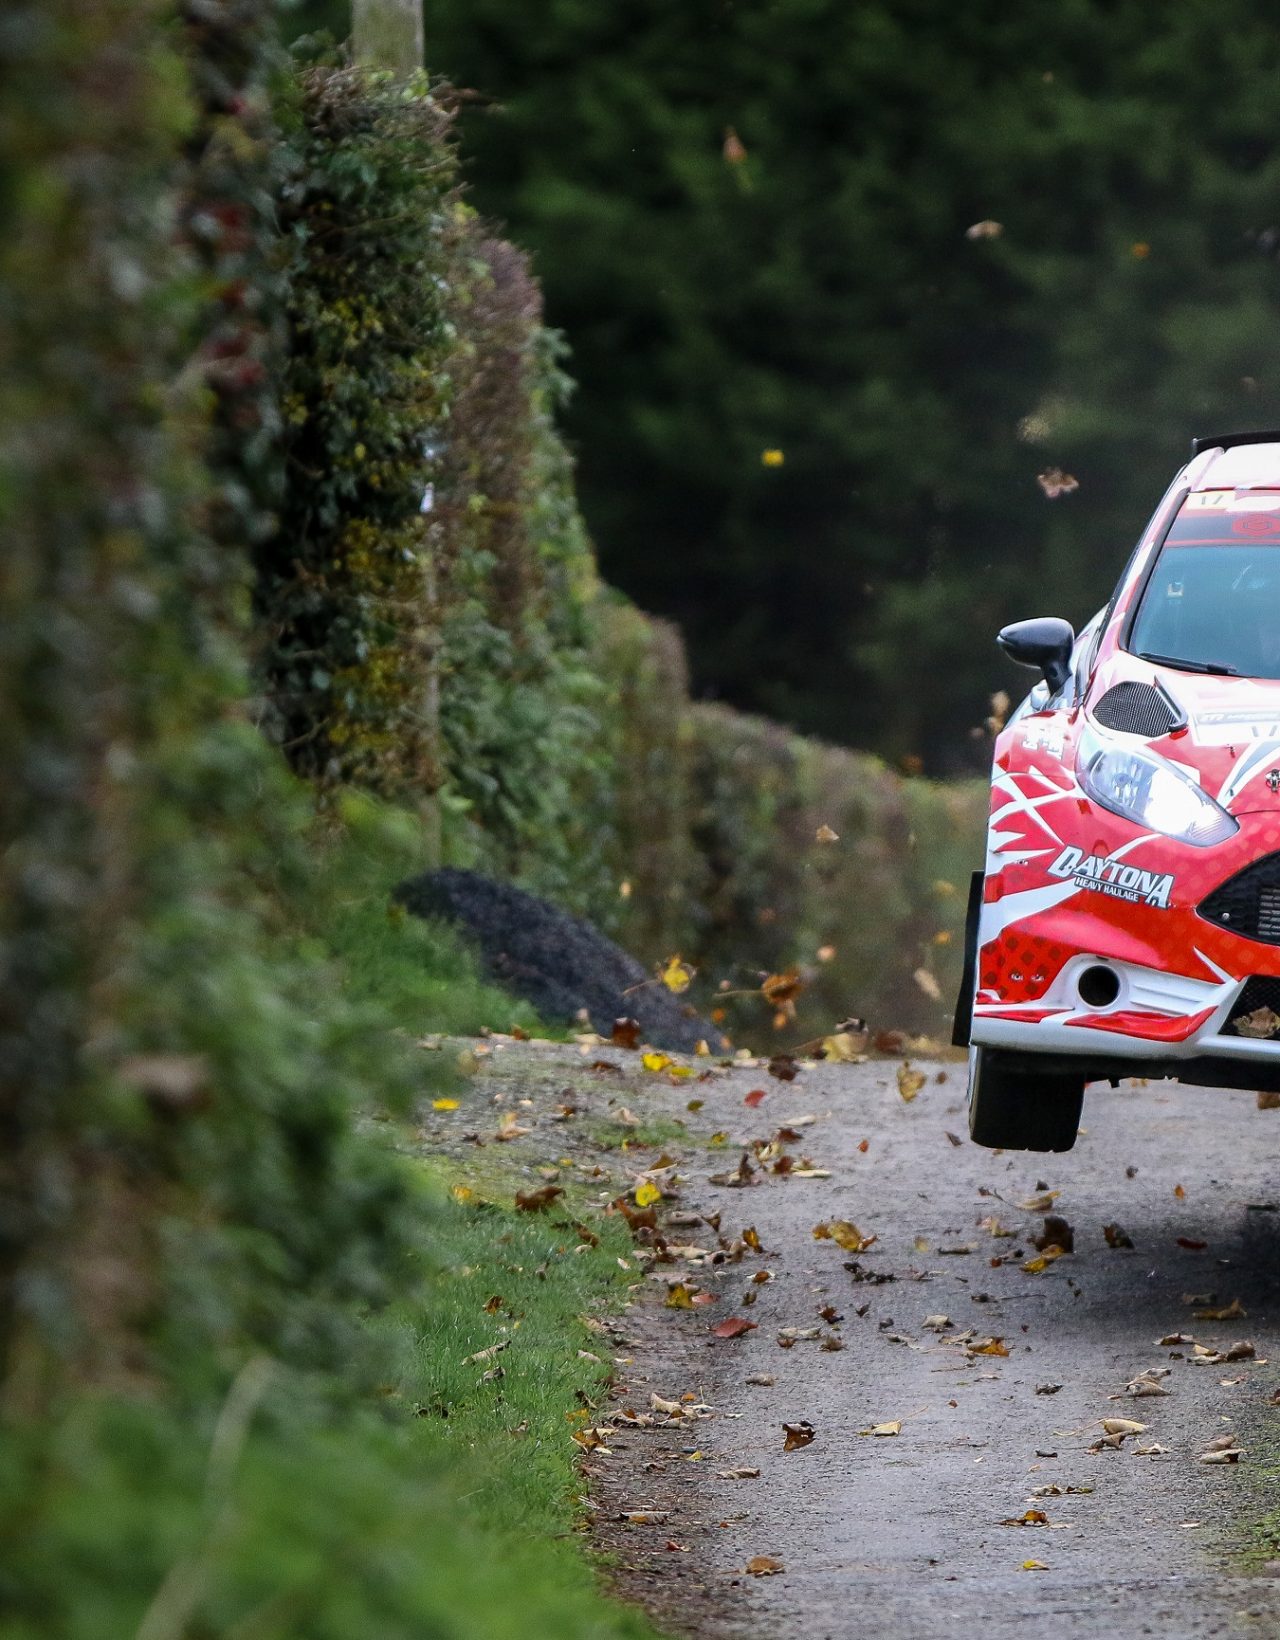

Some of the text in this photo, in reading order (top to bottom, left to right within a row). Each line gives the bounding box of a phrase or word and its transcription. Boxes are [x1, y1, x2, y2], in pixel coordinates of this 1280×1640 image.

[1047, 845, 1174, 908] DAYTONA
[1075, 876, 1139, 902] HEAVY HAULAGE
